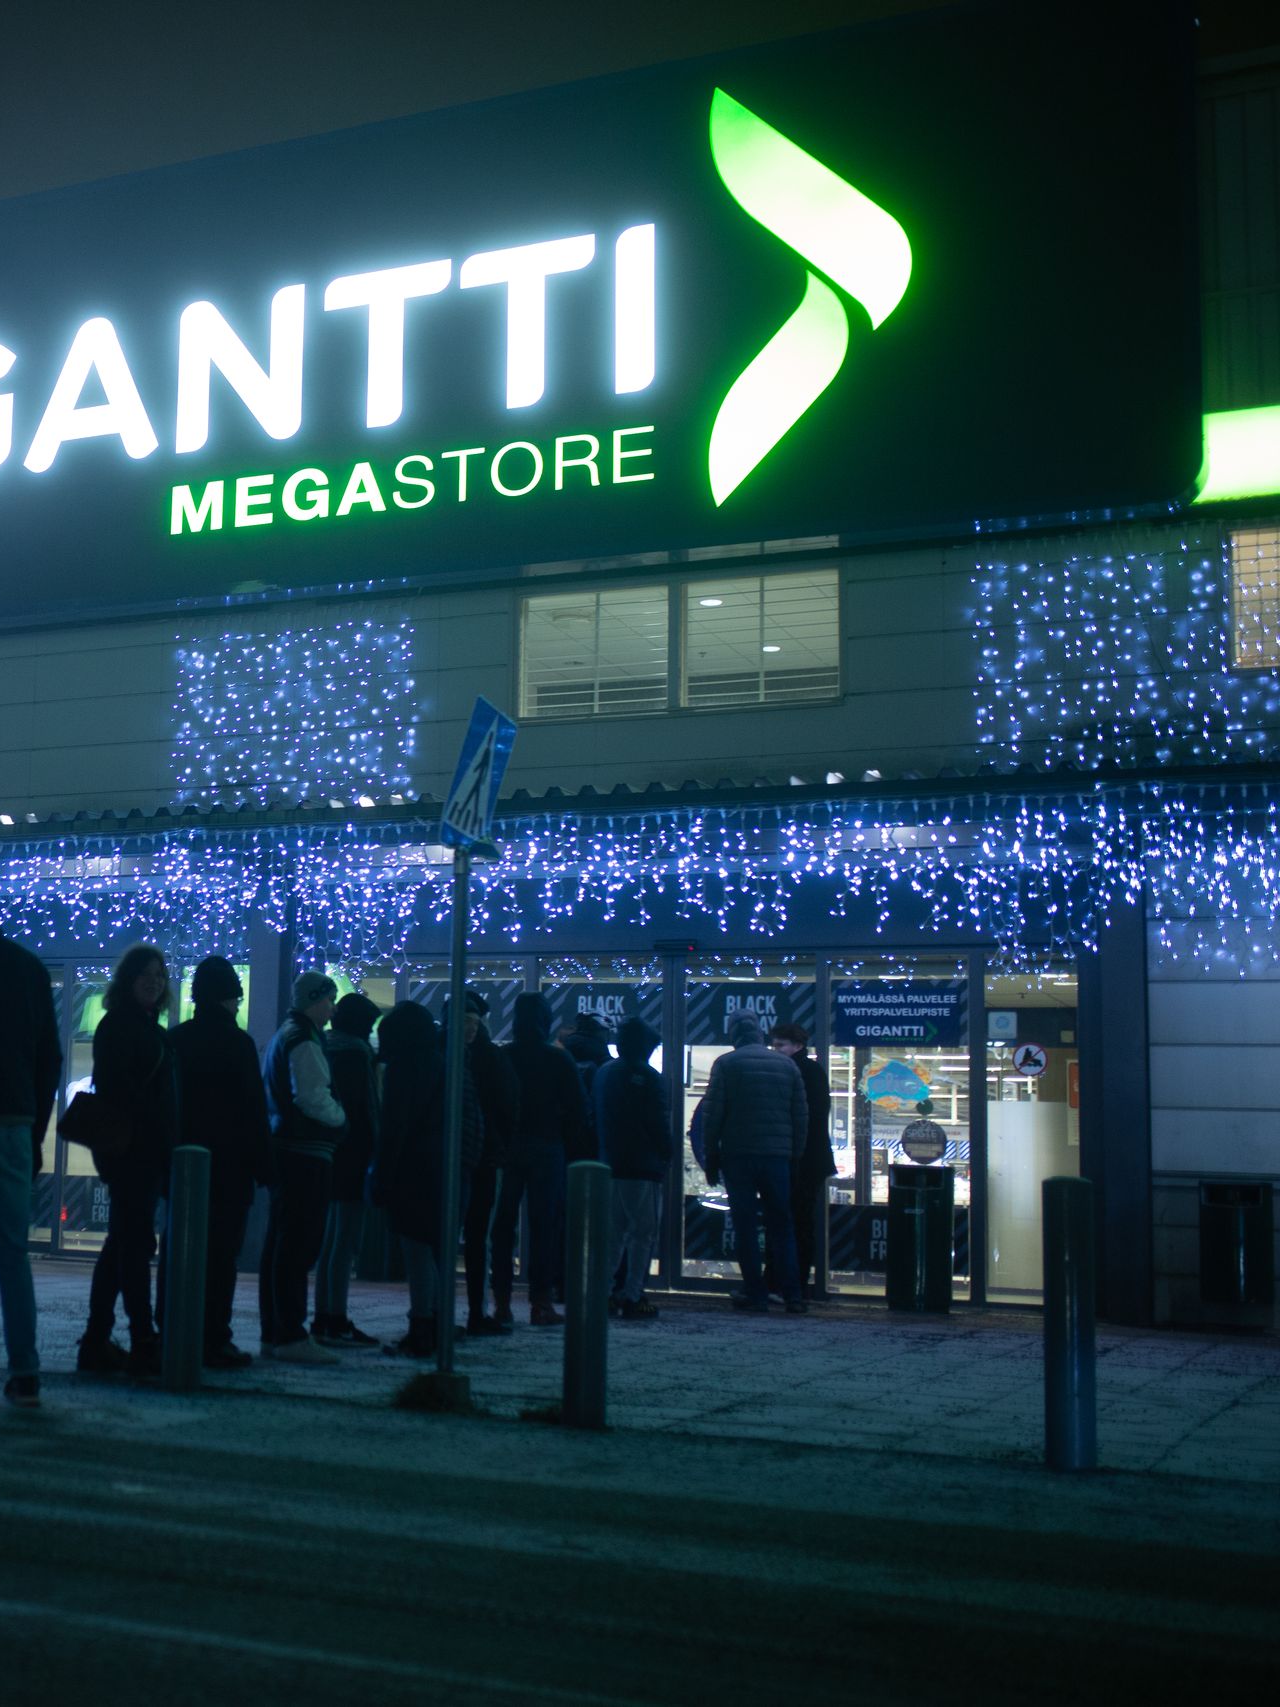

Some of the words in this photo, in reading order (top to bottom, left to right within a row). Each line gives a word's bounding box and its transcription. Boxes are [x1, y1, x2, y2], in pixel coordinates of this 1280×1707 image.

[169, 424, 656, 537] MEGASTORE
[577, 994, 625, 1014] BLACK
[837, 993, 905, 1004] MYYMÄLÄSSÄ
[907, 994, 958, 1004] PALVELEE
[843, 1007, 951, 1017] YRITYSPALVELUPISTE
[855, 1024, 925, 1037] GIGANTTI
